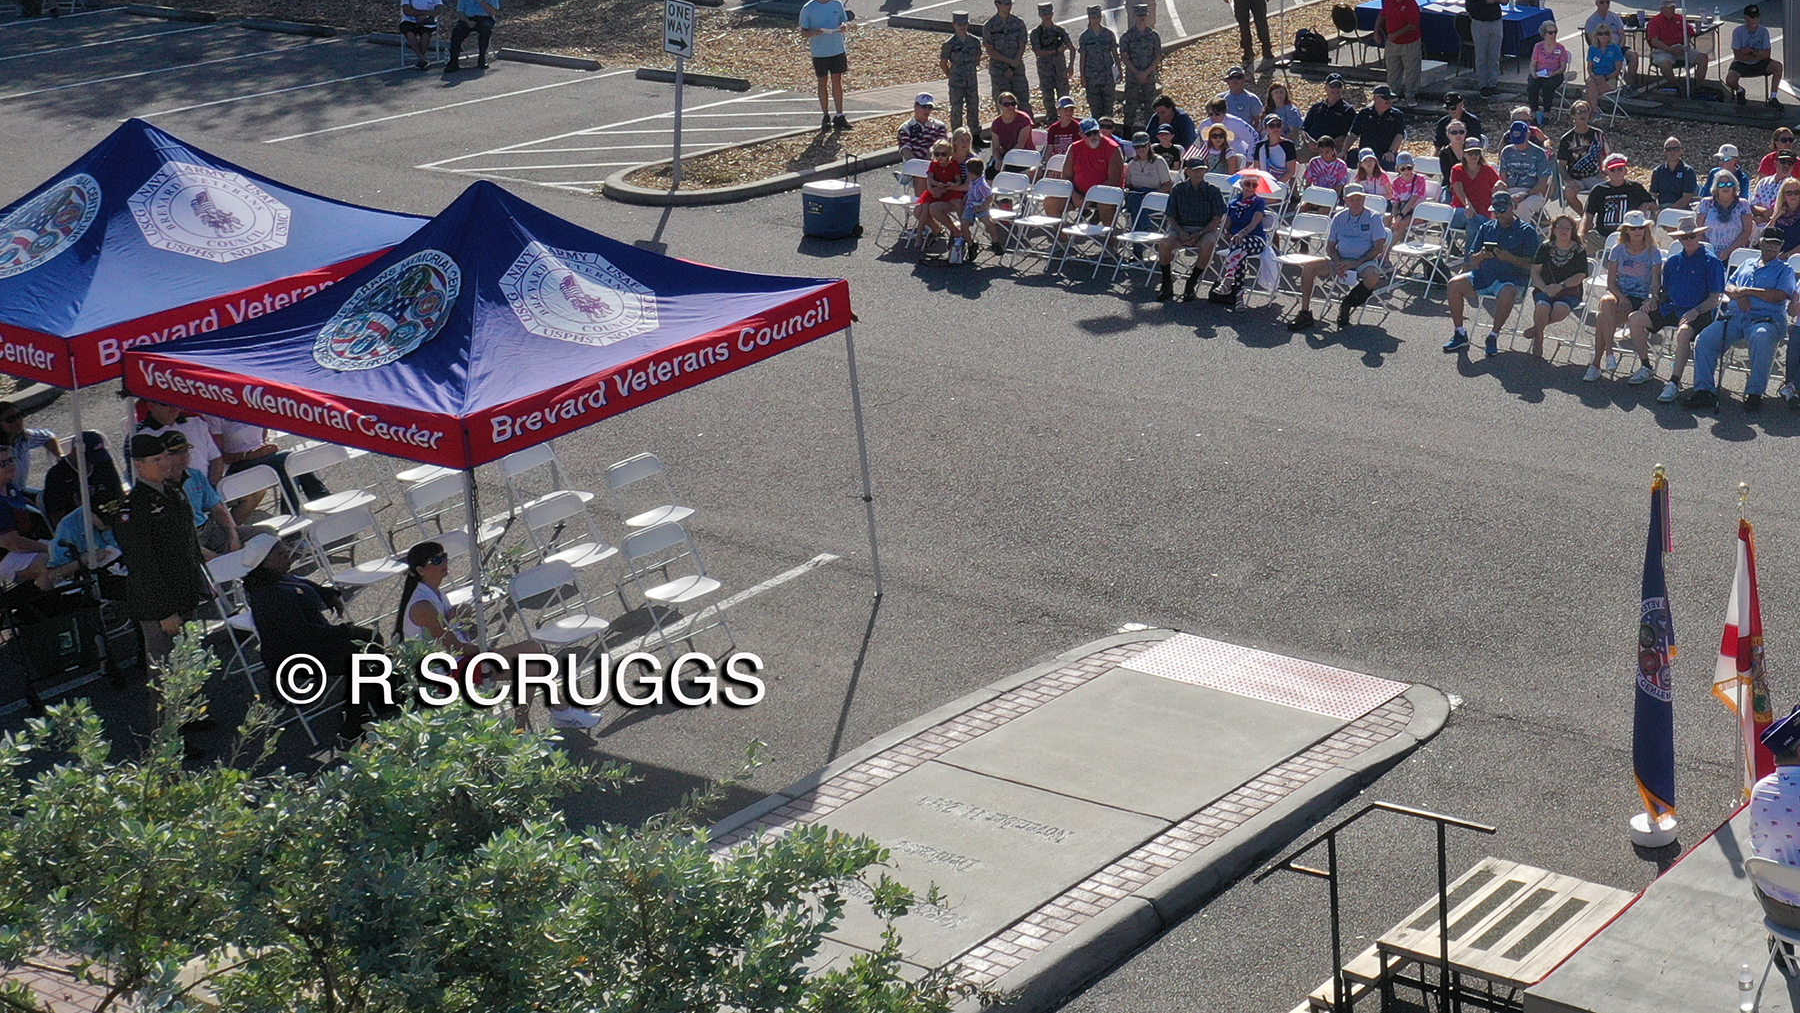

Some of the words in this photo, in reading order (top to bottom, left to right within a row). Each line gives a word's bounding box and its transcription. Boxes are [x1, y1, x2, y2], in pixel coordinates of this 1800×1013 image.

[668, 4, 690, 21] ONE
[667, 18, 690, 36] WAY
[137, 169, 170, 198] NAVY
[185, 164, 228, 180] ARMY
[157, 182, 181, 231] BREVARD
[193, 176, 265, 211] VETERANS
[244, 183, 279, 206] USAF
[134, 208, 158, 237] USCG
[275, 212, 289, 238] USMC
[206, 228, 265, 248] COUNCIL
[165, 241, 217, 260] USPHS
[230, 243, 273, 259] NOAA
[548, 247, 588, 261] ARMY
[506, 248, 536, 280] NAVY
[606, 265, 642, 289] USAF
[225, 276, 345, 325] Veteran
[506, 292, 533, 323] USCG
[543, 328, 595, 344] USPHS
[606, 325, 646, 342] NOAA
[490, 381, 606, 445] Brevard
[613, 338, 730, 398] Veterans
[737, 297, 831, 354] Council
[138, 360, 240, 406] Veterans
[241, 386, 354, 433] Memorial
[357, 414, 444, 450] Center
